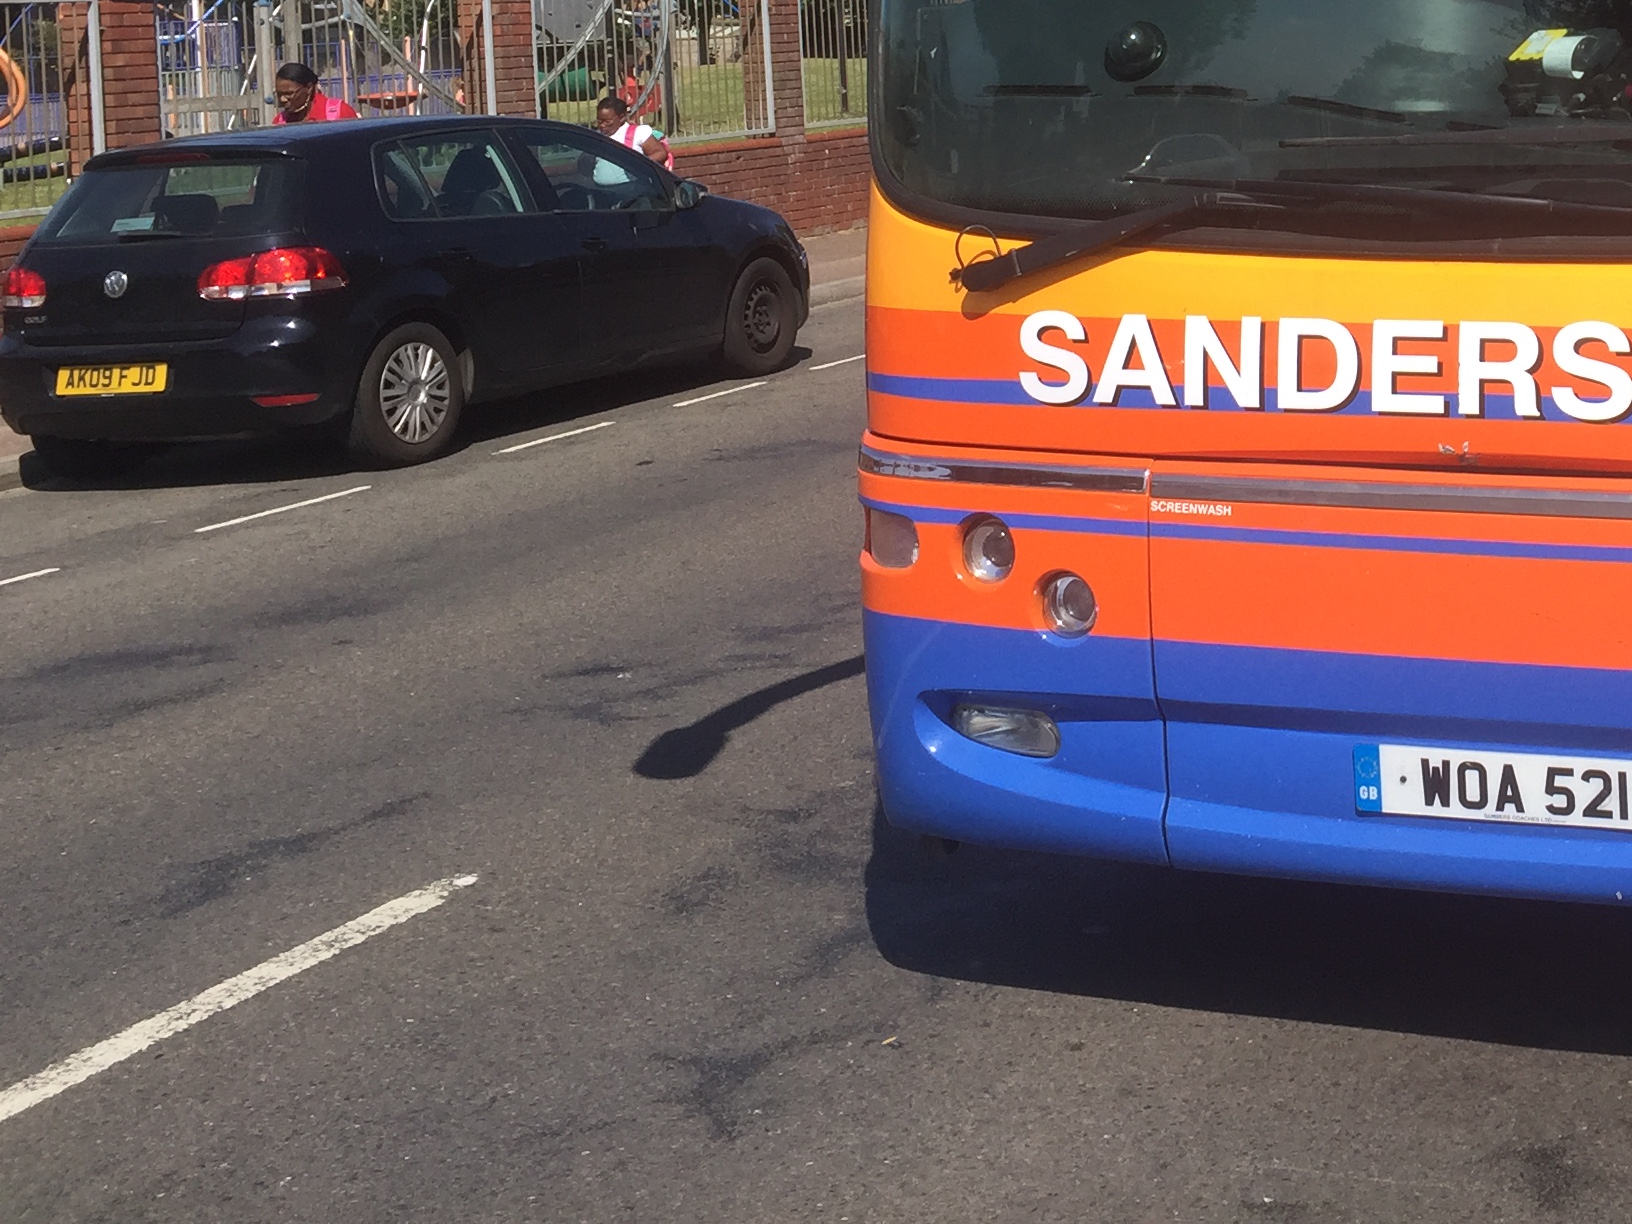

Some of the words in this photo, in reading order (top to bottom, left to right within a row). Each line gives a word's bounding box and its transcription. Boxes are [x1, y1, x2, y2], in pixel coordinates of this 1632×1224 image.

[65, 365, 113, 389] AK09
[117, 364, 156, 387] FJD
[1150, 500, 1232, 516] SCREENWASH
[1359, 785, 1378, 801] GB
[1420, 757, 1525, 814] WOA
[1545, 766, 1629, 821] 521
